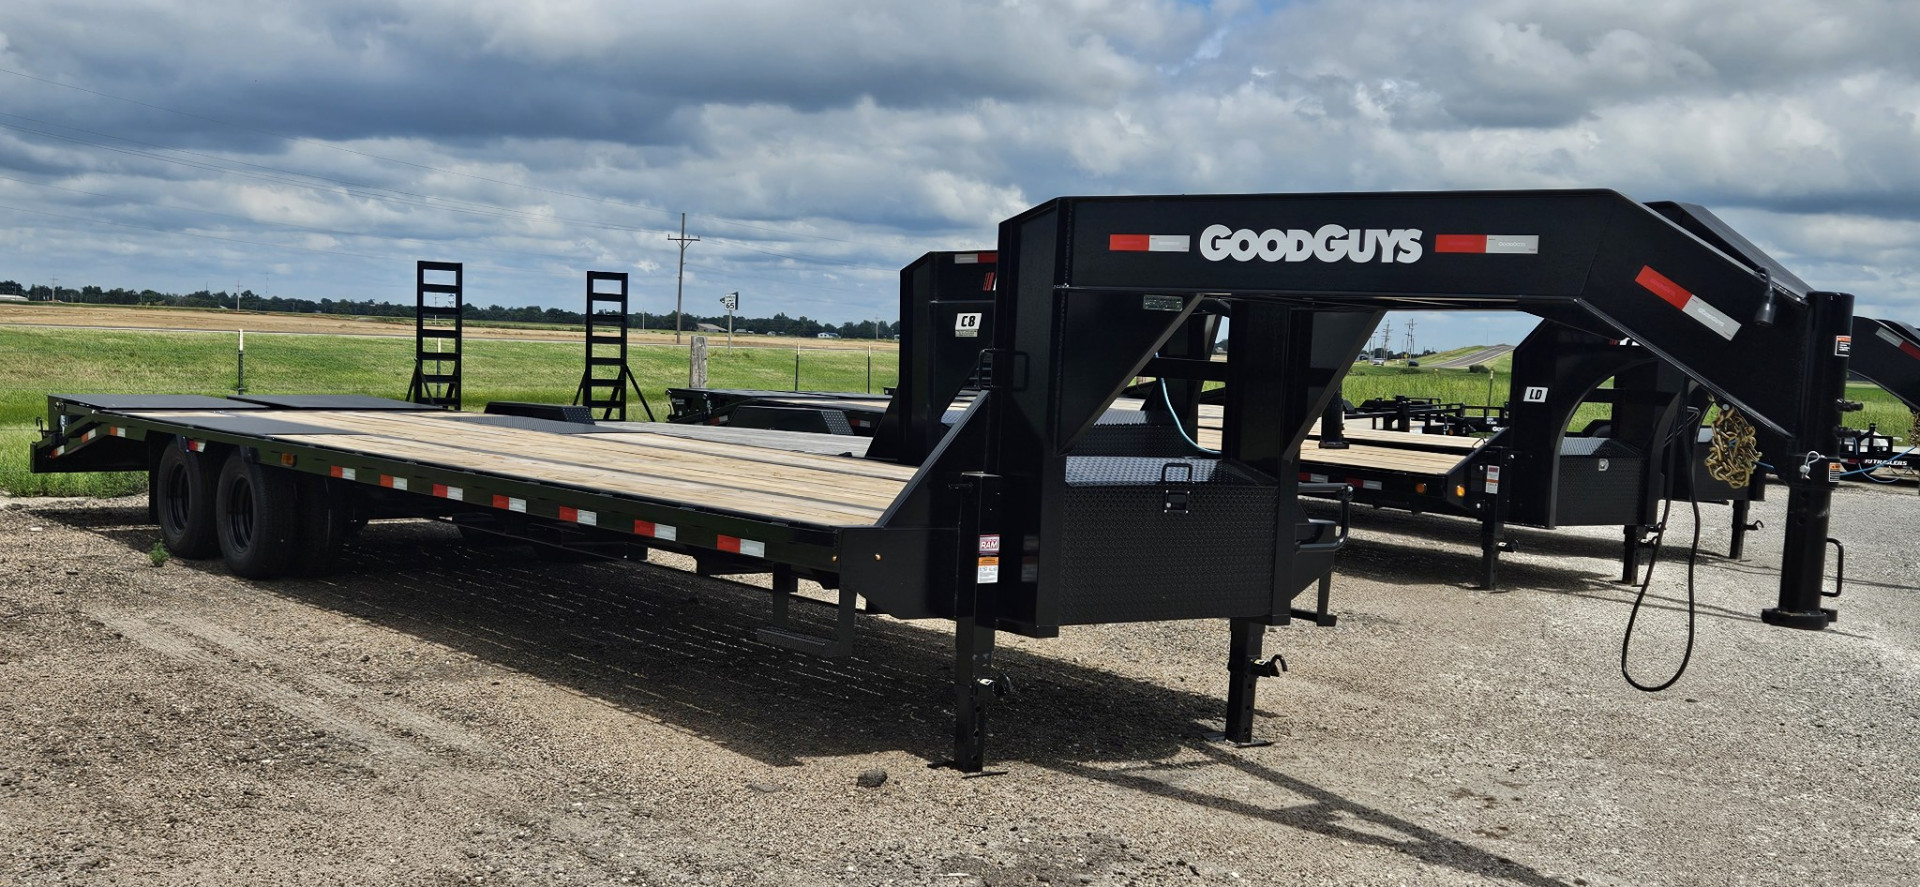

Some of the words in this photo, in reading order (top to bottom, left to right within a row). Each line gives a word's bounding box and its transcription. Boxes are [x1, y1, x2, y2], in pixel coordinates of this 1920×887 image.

[1199, 223, 1423, 263] GOODGUYS
[961, 315, 976, 327] C8
[1529, 388, 1543, 400] LD
